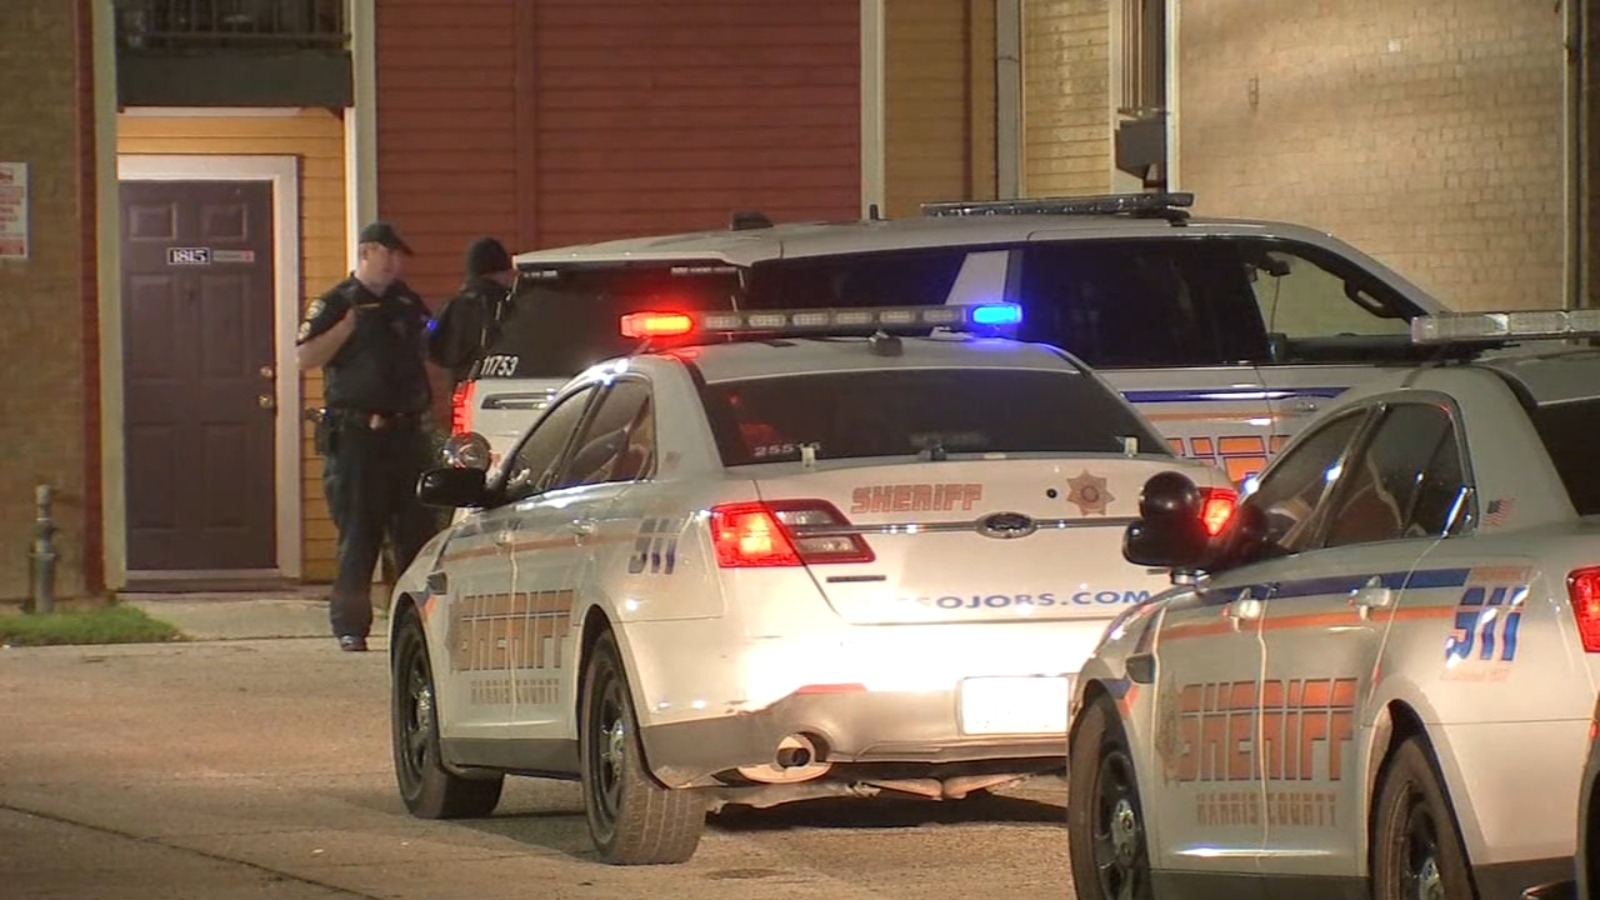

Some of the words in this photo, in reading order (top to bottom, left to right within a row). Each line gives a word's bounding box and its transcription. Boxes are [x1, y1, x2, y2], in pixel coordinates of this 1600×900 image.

[173, 250, 206, 261] 1815
[480, 355, 519, 376] 11753
[850, 484, 982, 514] SHERIFF
[628, 518, 680, 575] 911
[456, 589, 574, 671] SHERIFF
[1446, 587, 1528, 664] 911
[1172, 677, 1358, 782] SHERIFF
[1196, 793, 1259, 826] HARRIS
[1266, 792, 1337, 827] COUNTY
